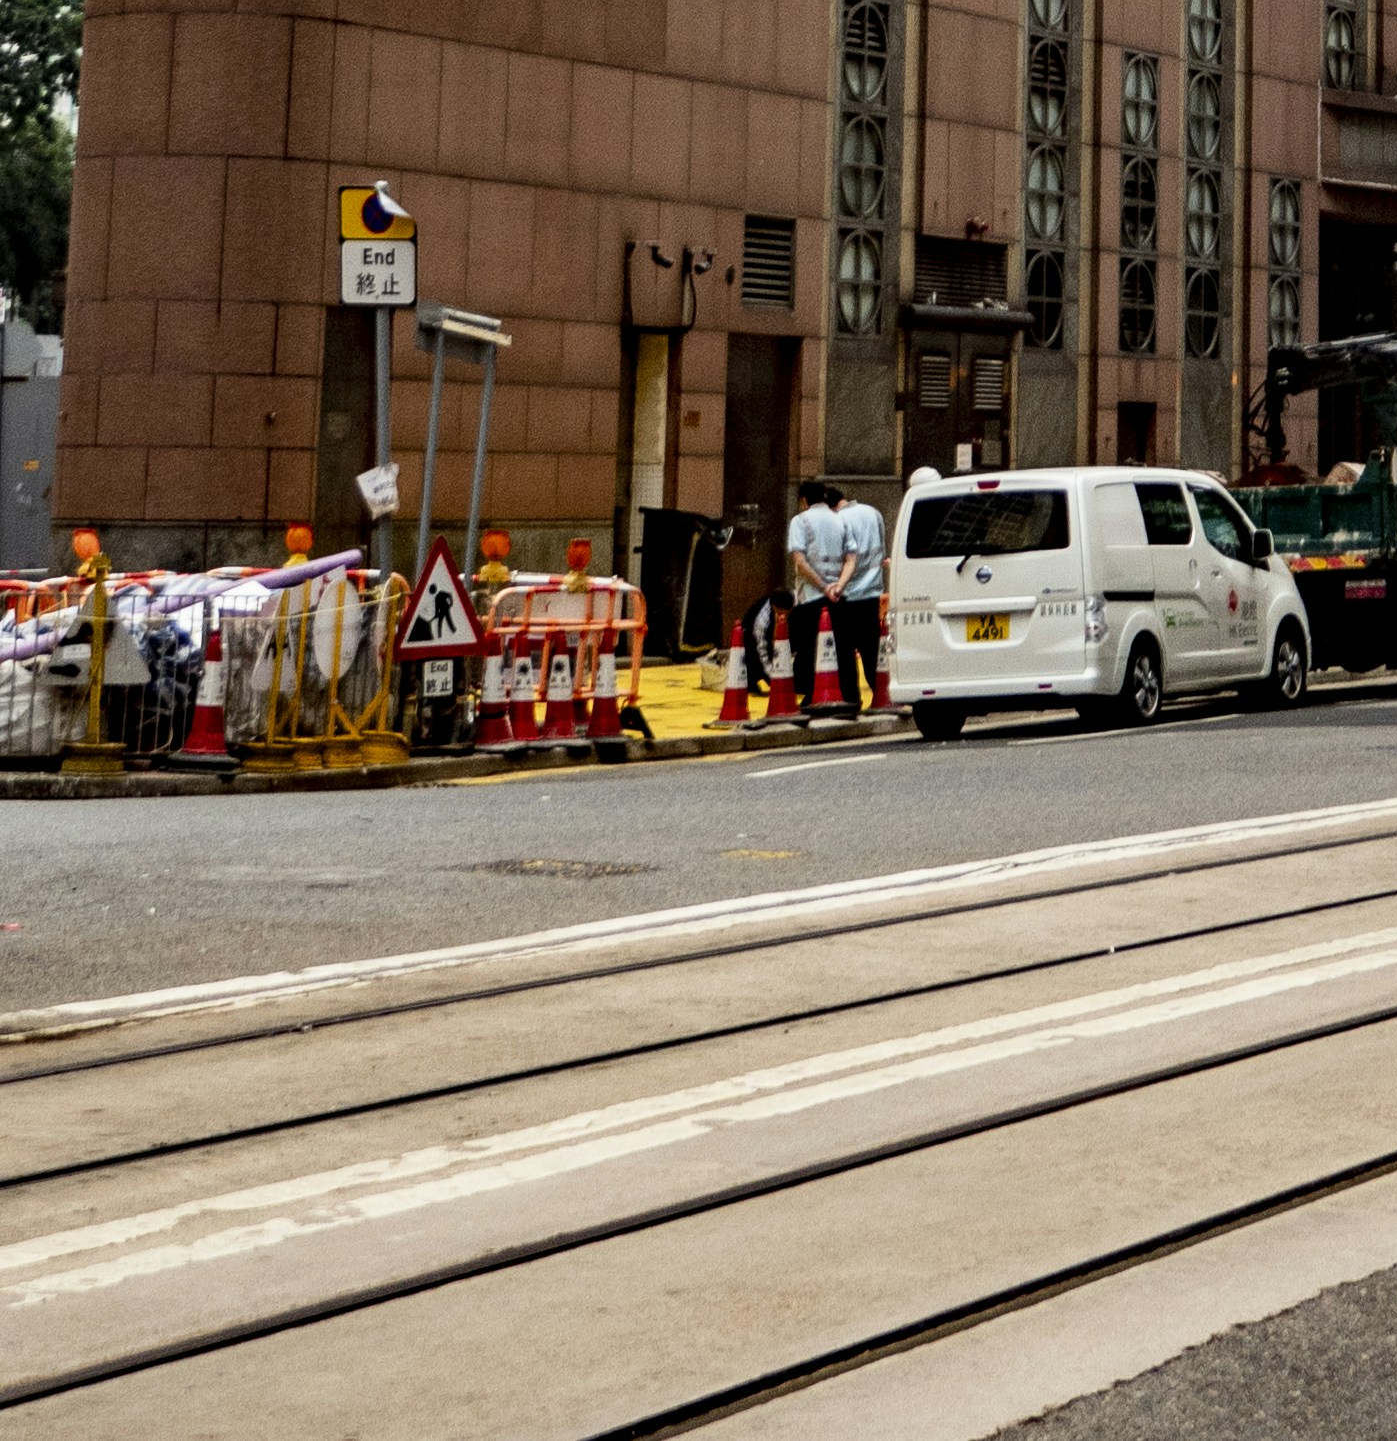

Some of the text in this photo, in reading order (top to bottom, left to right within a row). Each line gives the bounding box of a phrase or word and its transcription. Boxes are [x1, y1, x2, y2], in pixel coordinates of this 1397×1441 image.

[363, 247, 396, 265] End
[356, 272, 401, 296] 終止
[972, 626, 1004, 640] 4491
